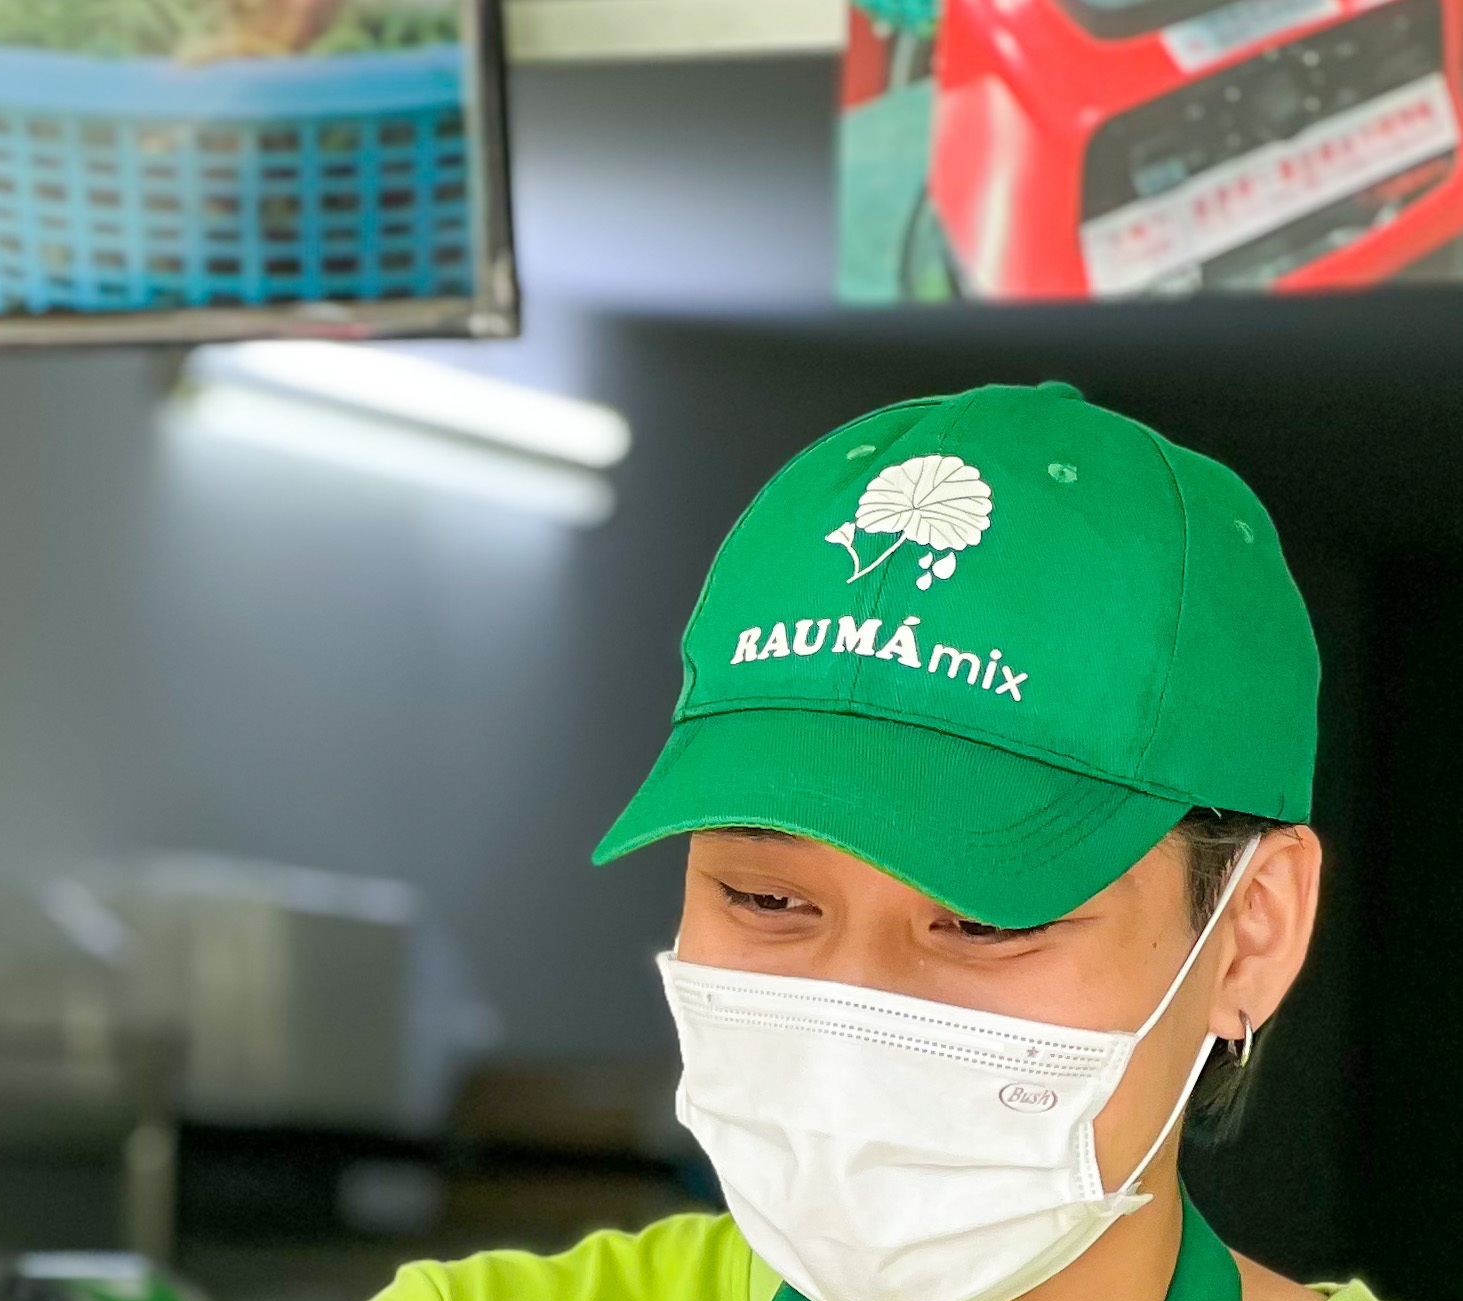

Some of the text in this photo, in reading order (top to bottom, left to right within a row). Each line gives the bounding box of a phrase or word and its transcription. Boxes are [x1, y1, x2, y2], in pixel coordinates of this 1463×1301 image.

[730, 615, 1028, 702] RAU MÁ mix
